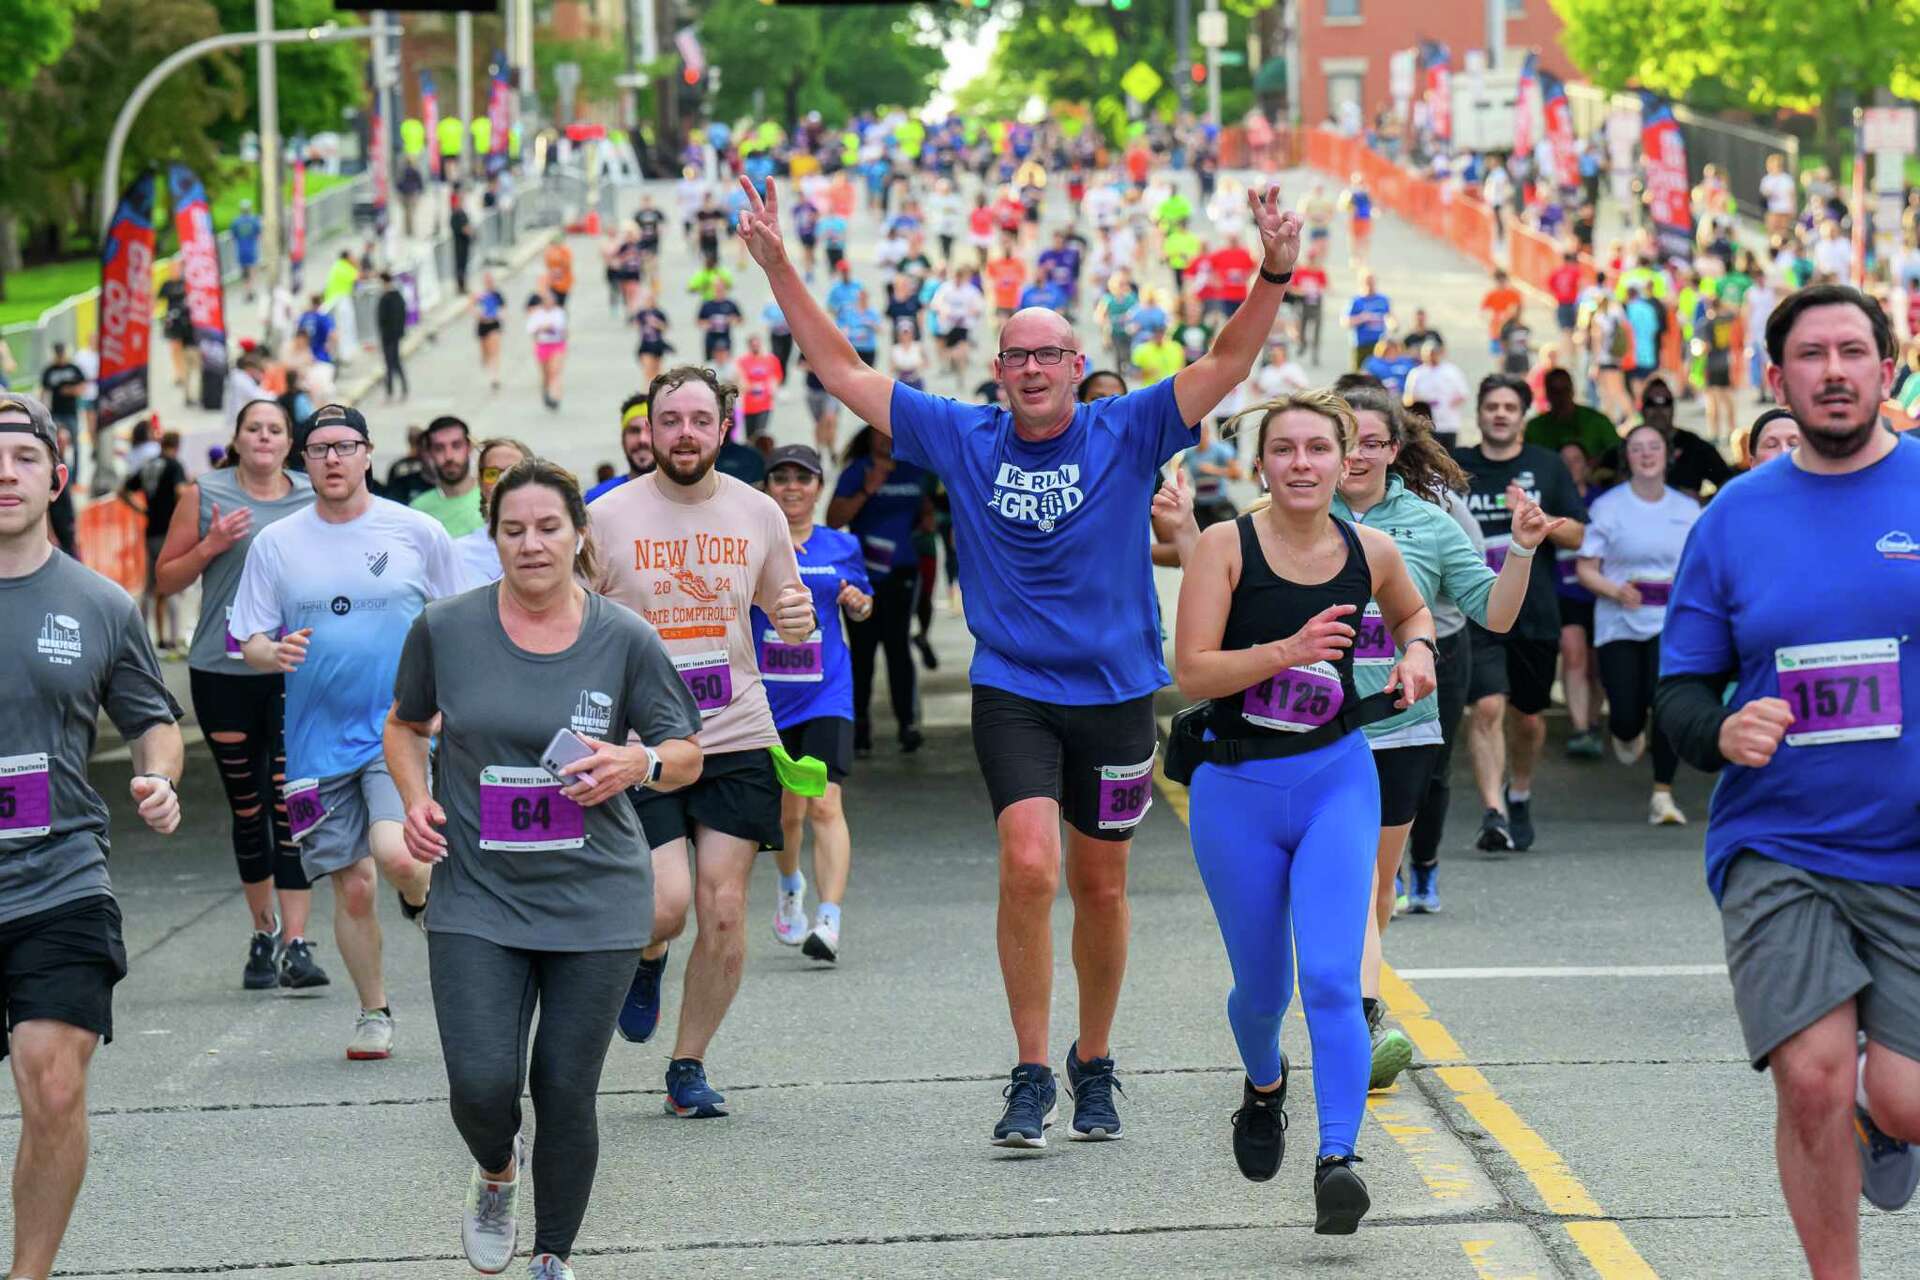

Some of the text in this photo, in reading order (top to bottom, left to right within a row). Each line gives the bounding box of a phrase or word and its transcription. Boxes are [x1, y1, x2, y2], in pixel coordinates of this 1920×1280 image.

[634, 533, 749, 570] NEW YORK
[654, 577, 731, 596] 20 24
[691, 674, 722, 701] 50
[1255, 677, 1331, 717] 4125
[1793, 675, 1881, 721] 1571
[0, 786, 17, 818] 5
[511, 796, 551, 831] 64
